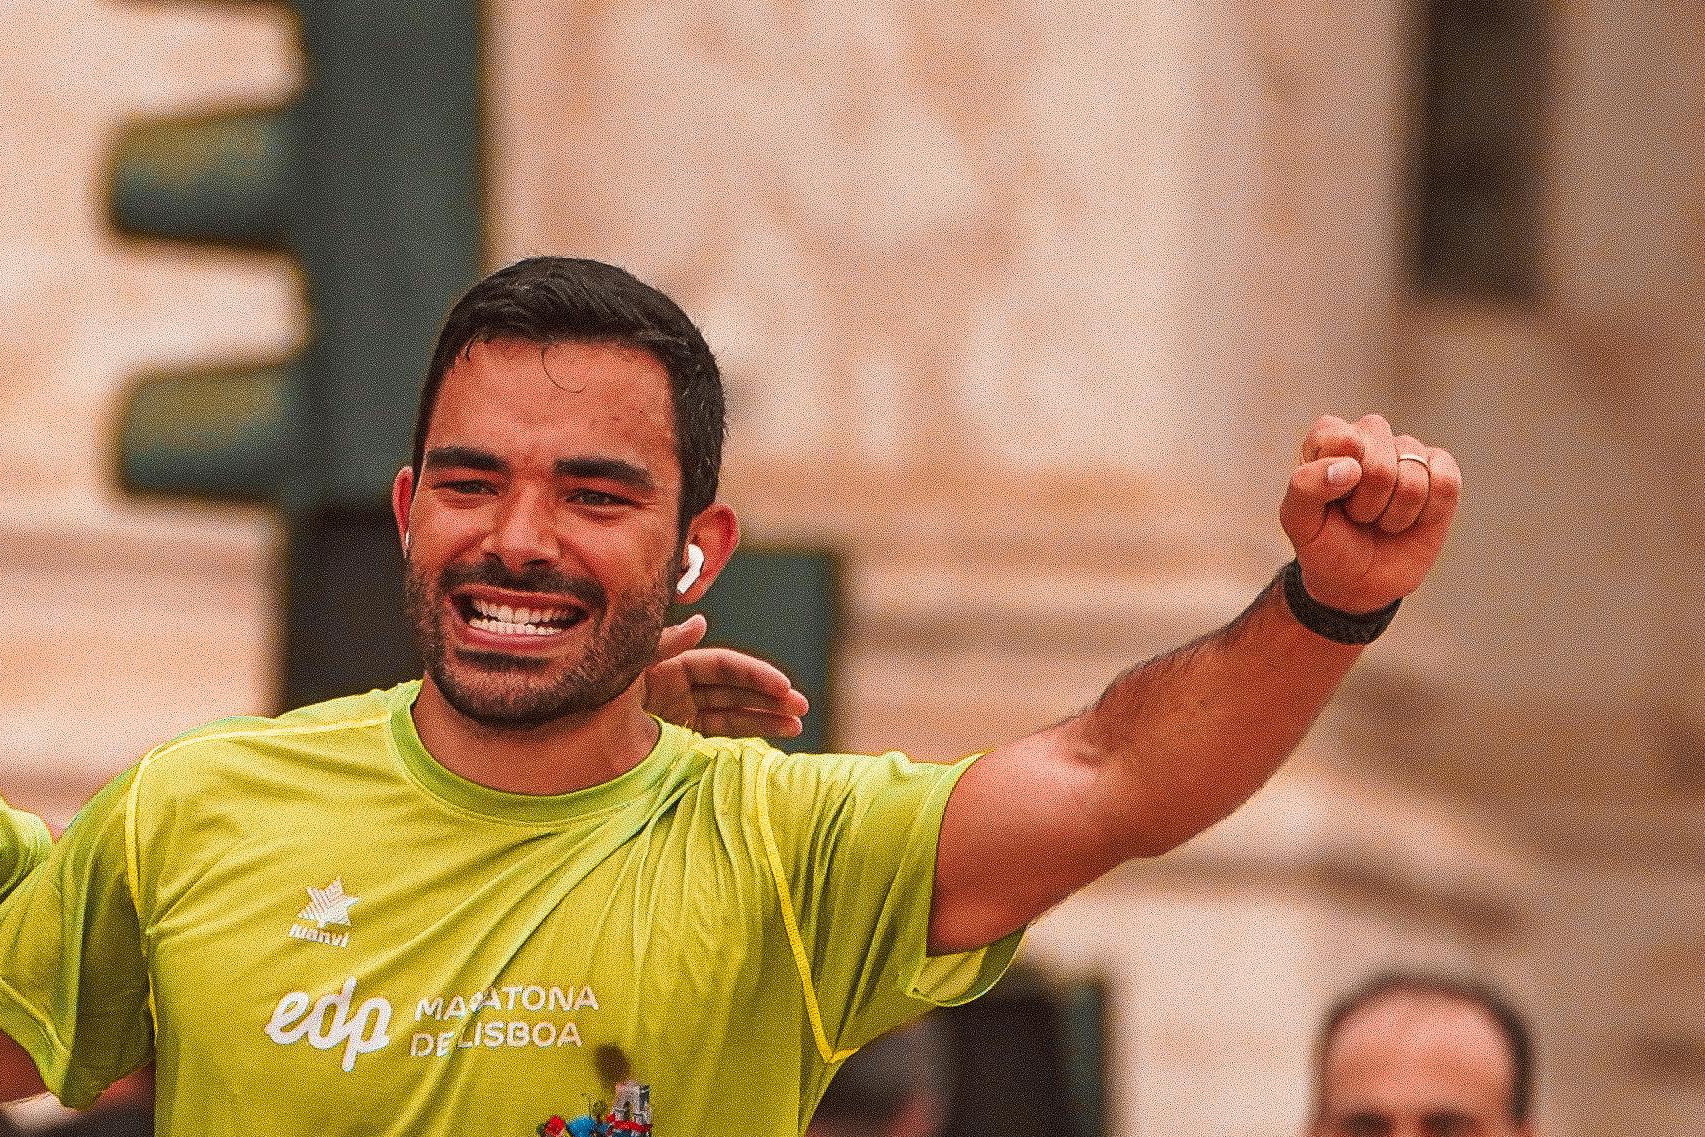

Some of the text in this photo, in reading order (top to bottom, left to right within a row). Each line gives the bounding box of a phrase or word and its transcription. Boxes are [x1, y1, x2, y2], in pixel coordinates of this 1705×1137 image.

[264, 976, 599, 1072] edp MARATONA
[409, 1030, 455, 1057] DE
